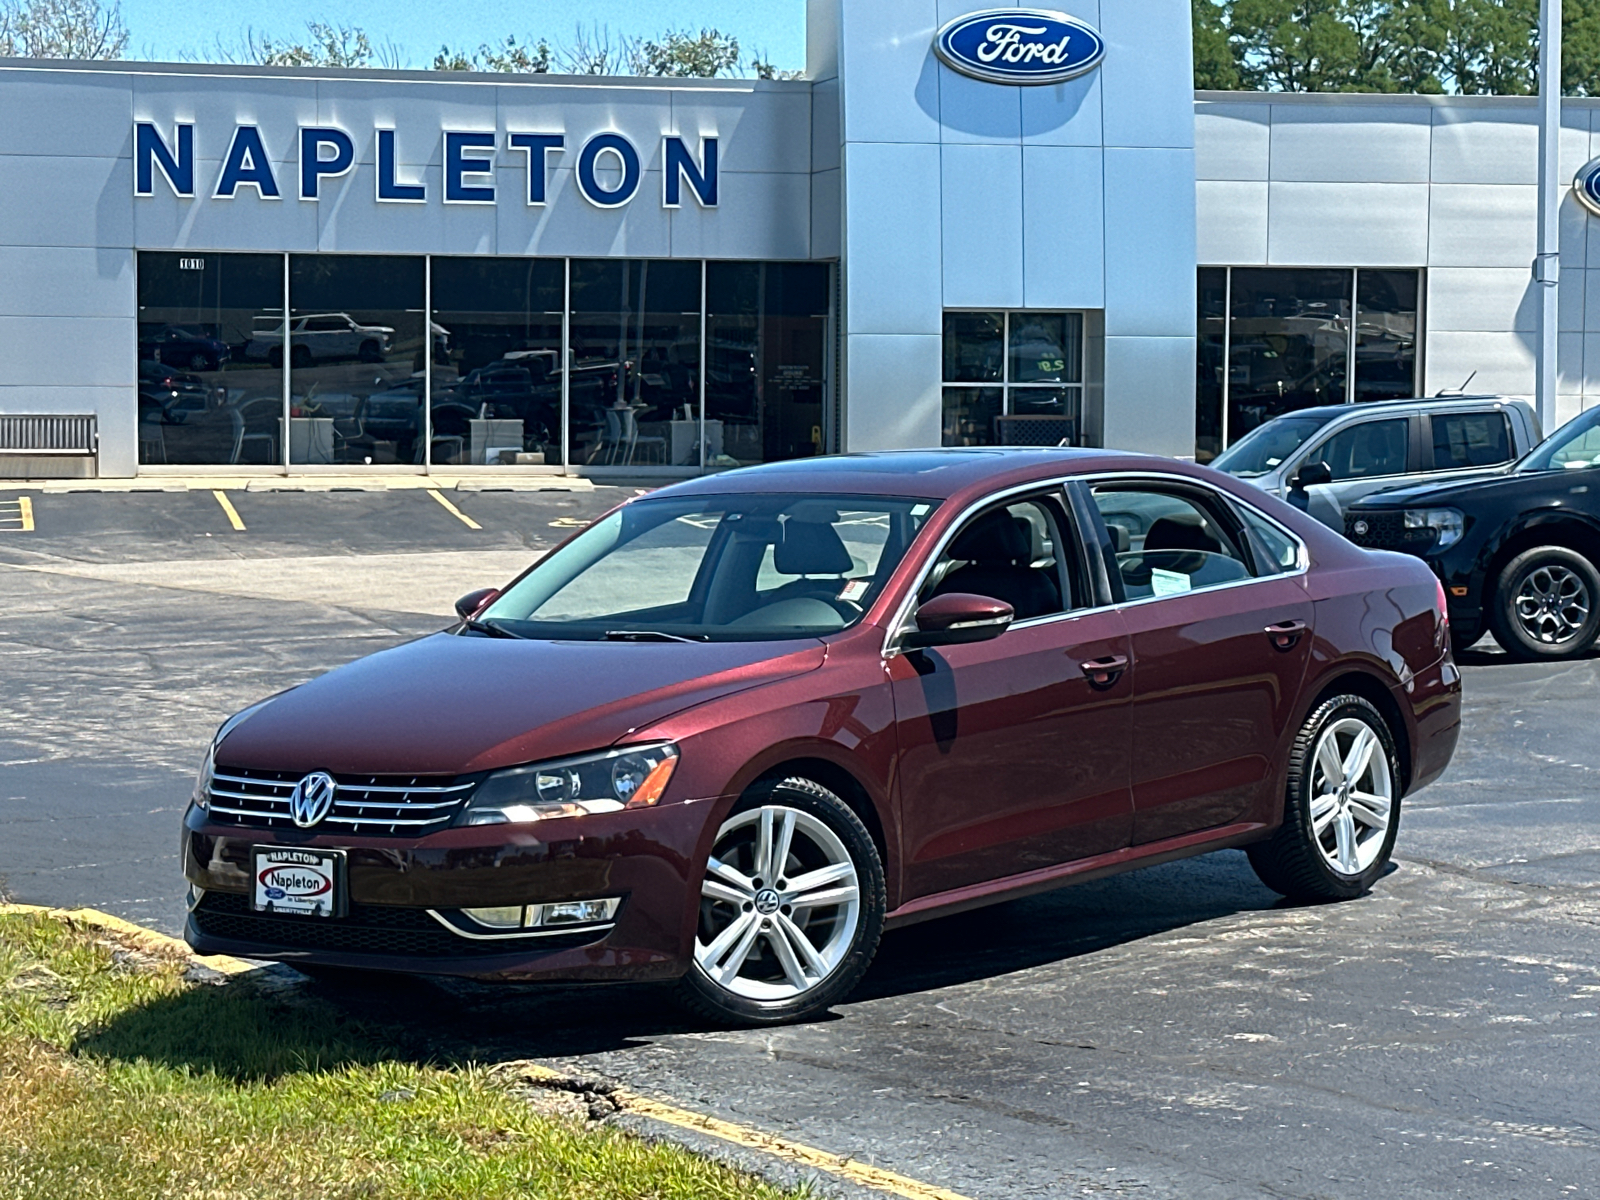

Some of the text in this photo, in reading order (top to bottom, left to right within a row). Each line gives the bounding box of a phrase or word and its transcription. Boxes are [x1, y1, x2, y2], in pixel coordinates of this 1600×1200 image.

[976, 24, 1071, 65] Ford
[133, 121, 719, 209] NAPLETON
[180, 258, 204, 270] 1010
[270, 851, 317, 865] NAPLETON
[270, 871, 320, 891] Napleton
